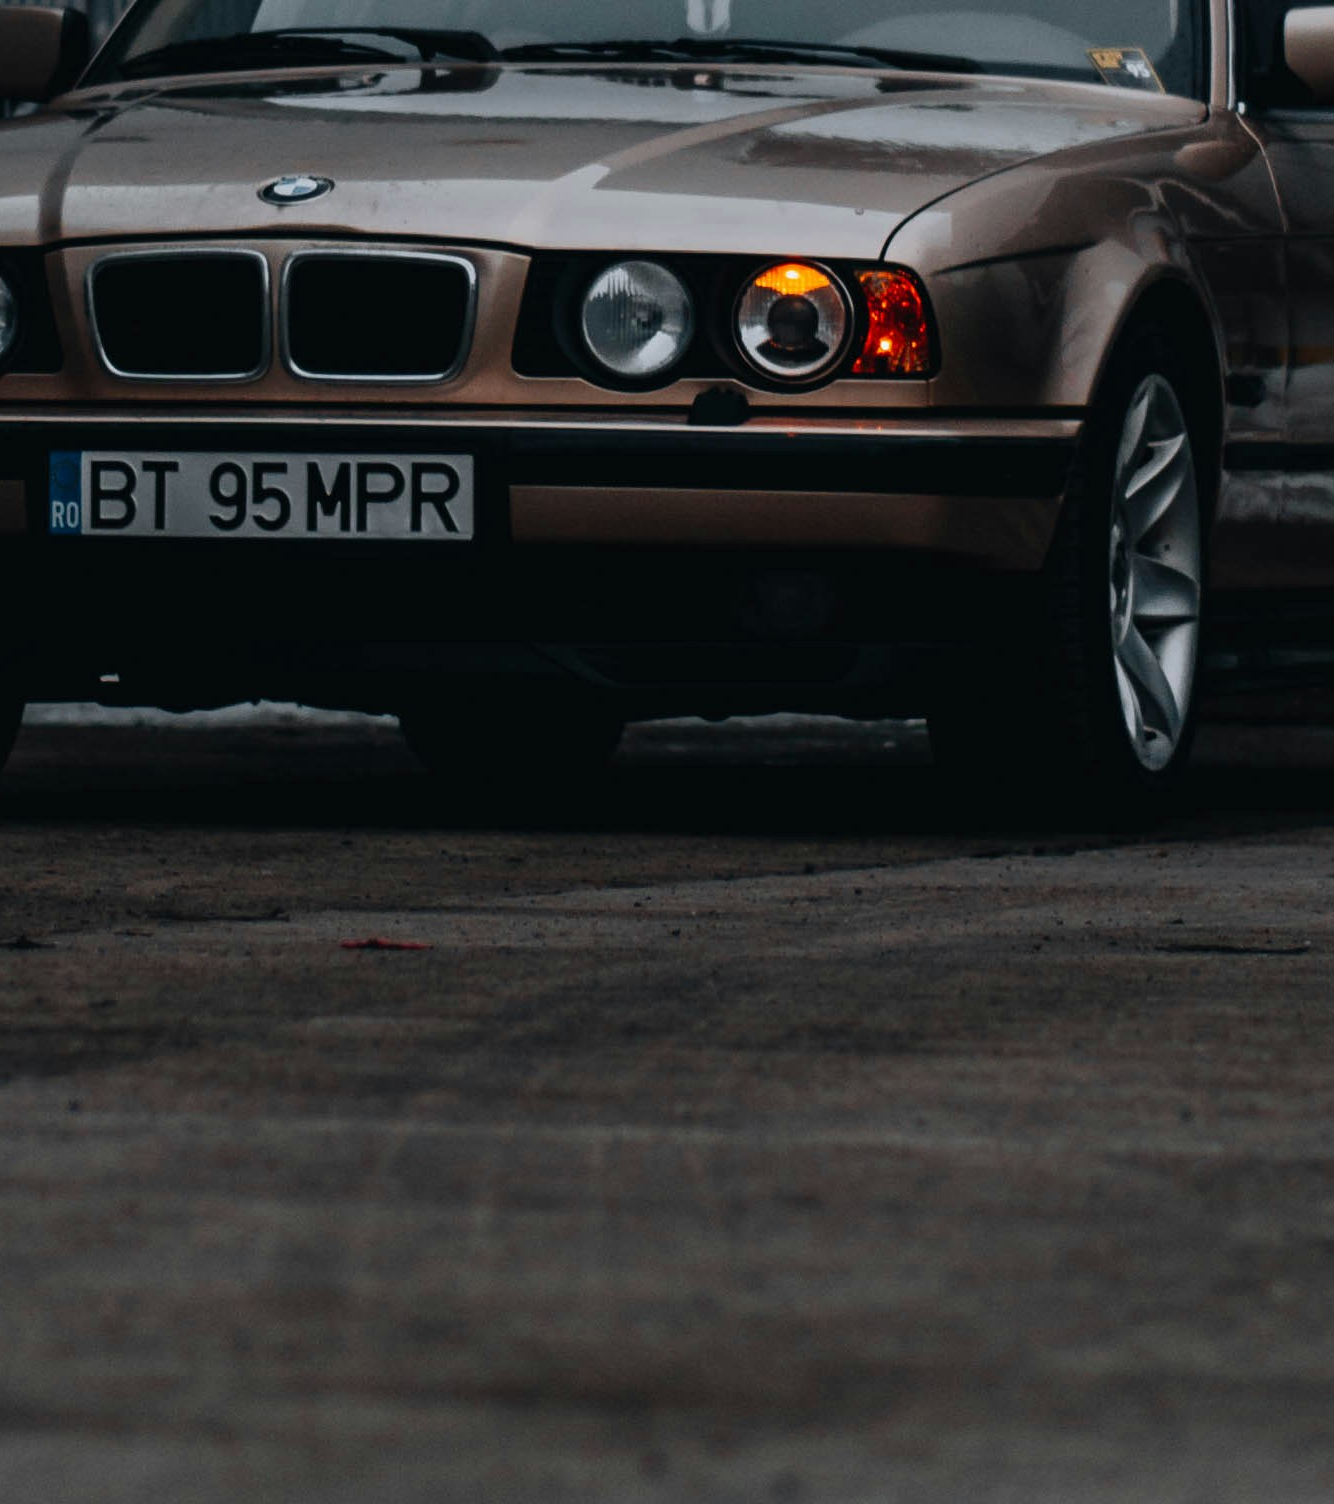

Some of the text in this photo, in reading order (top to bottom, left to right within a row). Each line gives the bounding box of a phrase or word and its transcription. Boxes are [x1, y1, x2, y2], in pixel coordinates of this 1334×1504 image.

[51, 500, 79, 528] RO
[89, 460, 461, 533] BT 95 MPR
